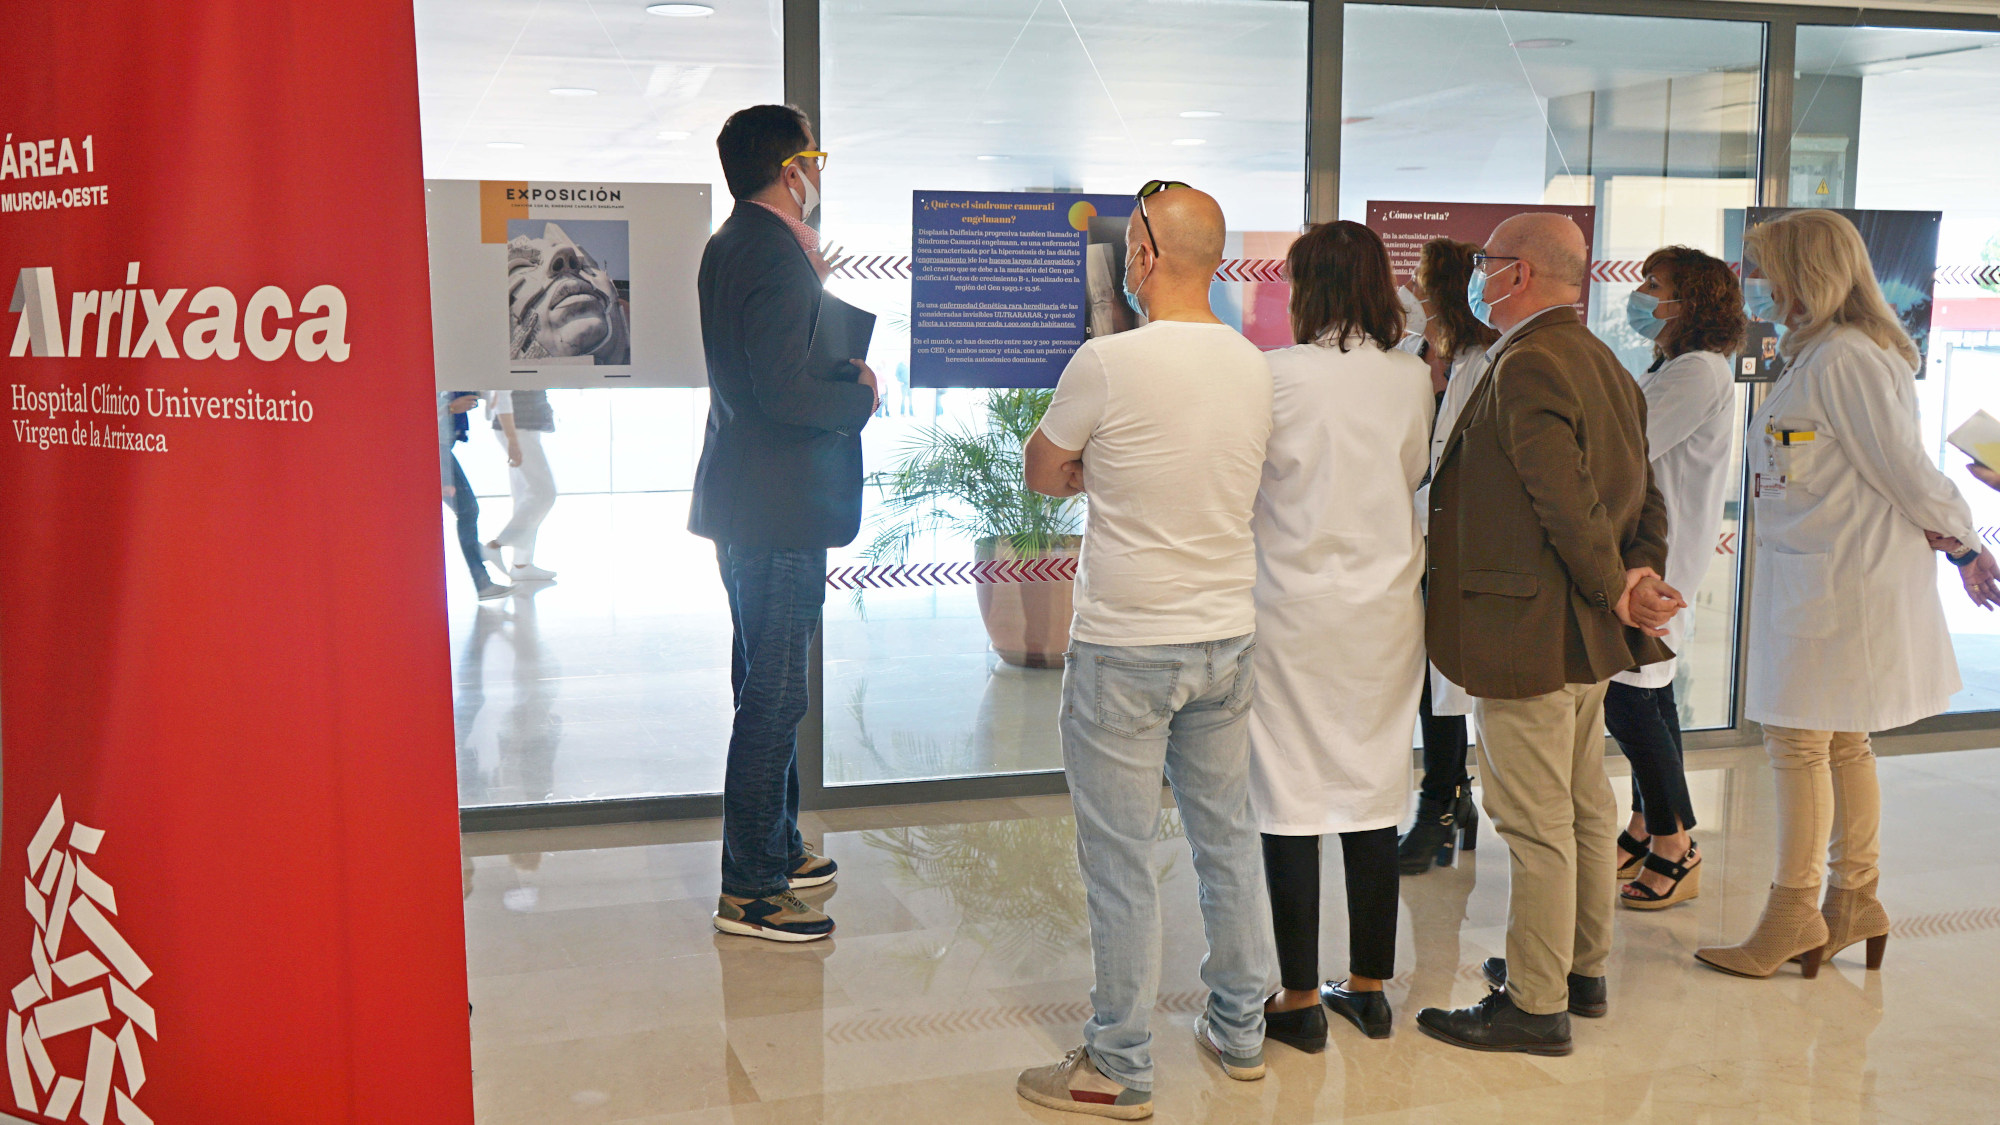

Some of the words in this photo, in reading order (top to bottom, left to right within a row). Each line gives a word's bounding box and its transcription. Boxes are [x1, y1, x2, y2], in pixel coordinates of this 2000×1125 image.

[0, 133, 78, 180] ÁREA
[82, 135, 94, 172] 1
[1, 185, 108, 212] MURCIA-OESTE
[506, 187, 621, 201] EXPOSICIÓN
[931, 200, 948, 210] Qué
[962, 201, 969, 209] el
[1014, 202, 1055, 211] camurati
[962, 214, 1016, 225] engelmann?
[1389, 210, 1413, 220] Cómo
[1424, 212, 1450, 220] trata?
[919, 229, 948, 237] Displasia
[985, 230, 1018, 238] progresiva
[1012, 258, 1032, 266] largos
[955, 284, 976, 292] región
[8, 261, 350, 362] Arrixaca
[1086, 326, 1092, 335] D
[11, 384, 87, 418] Hospital
[91, 383, 140, 416] Clínico
[146, 387, 313, 422] Universitario
[12, 419, 68, 450] Virgen
[72, 421, 88, 446] de
[90, 420, 100, 447] la
[102, 424, 168, 452] Arrixaca
